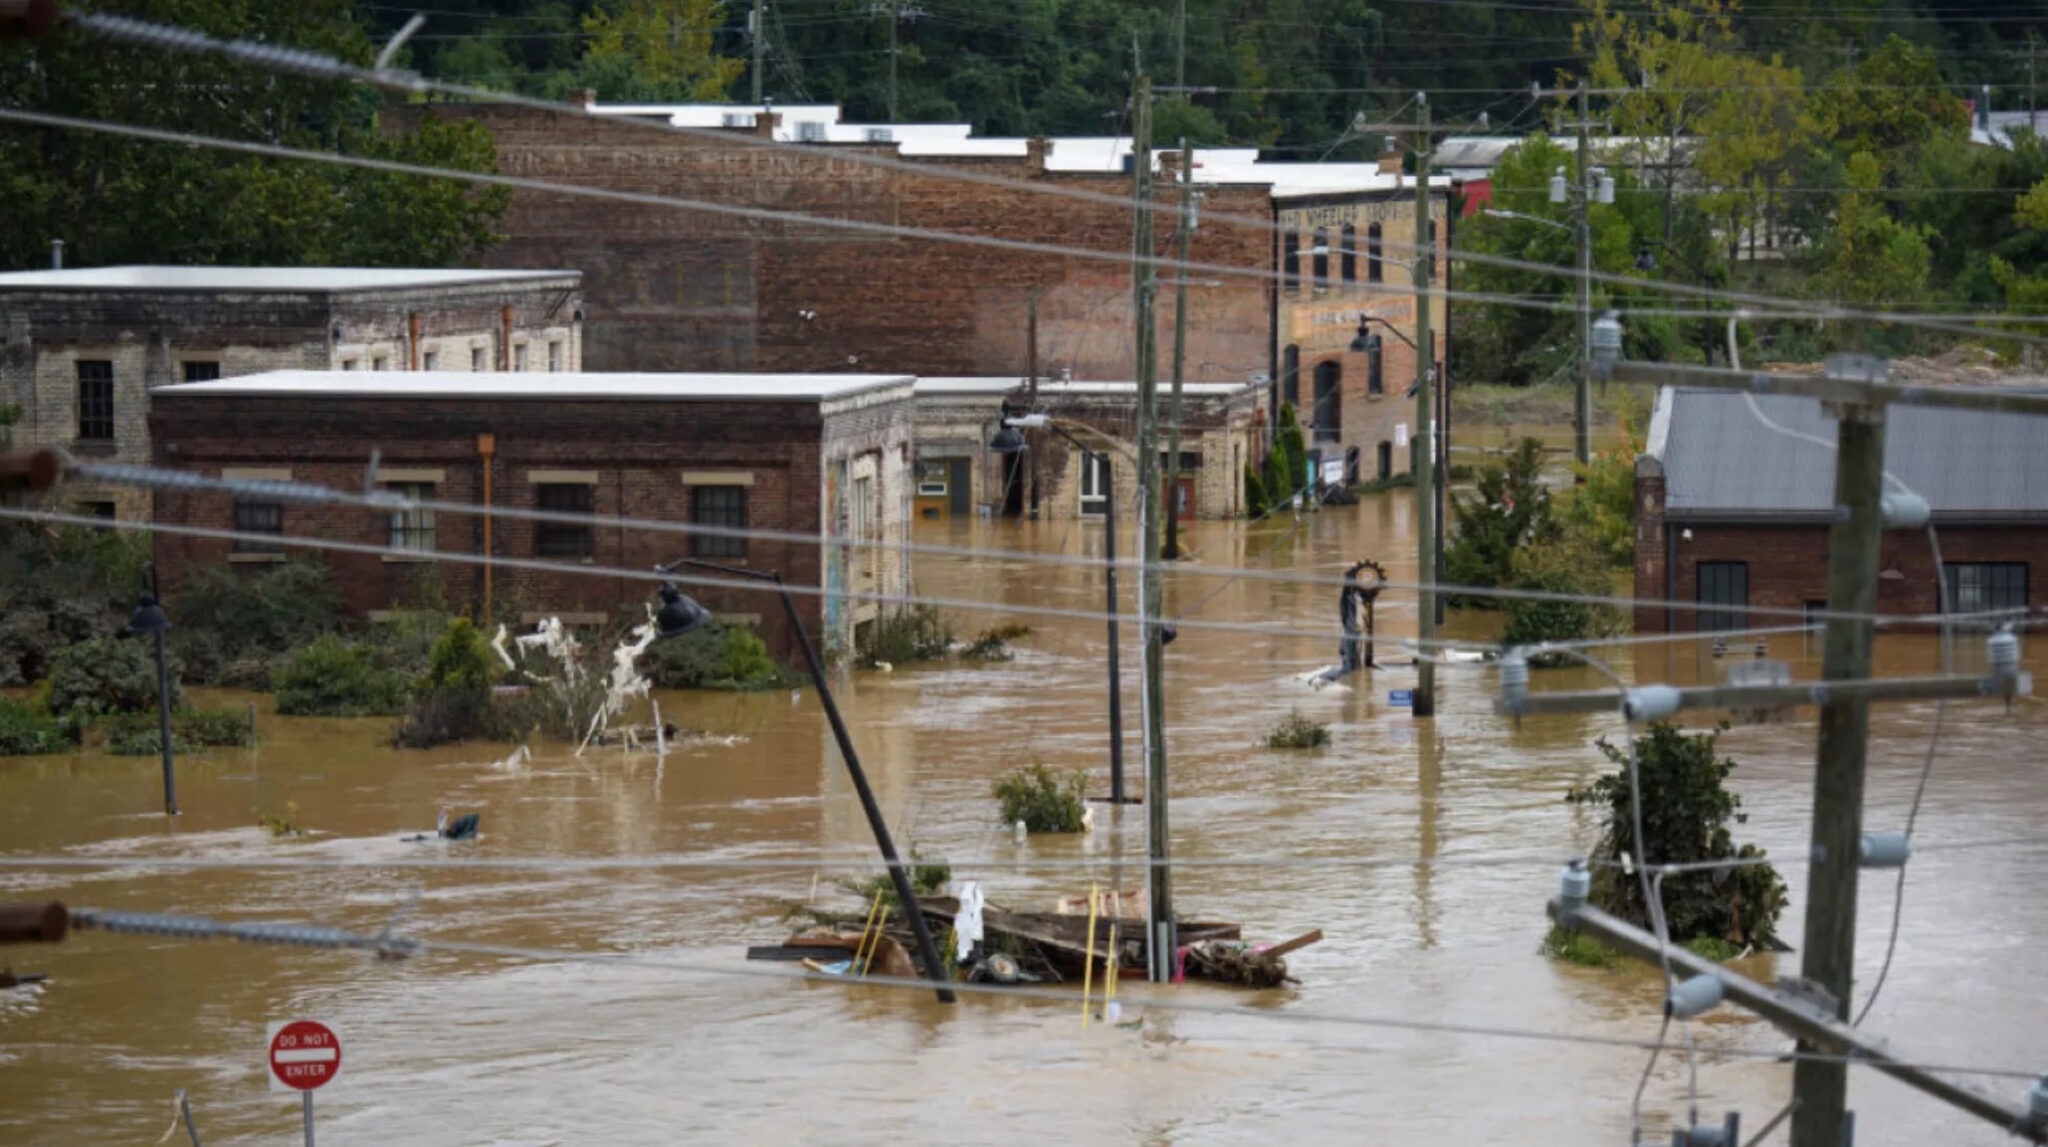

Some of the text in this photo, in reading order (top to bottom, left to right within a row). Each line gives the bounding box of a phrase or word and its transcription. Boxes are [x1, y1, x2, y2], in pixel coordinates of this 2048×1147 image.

[280, 1033, 329, 1047] DO NOT
[286, 1064, 326, 1077] ENTER
